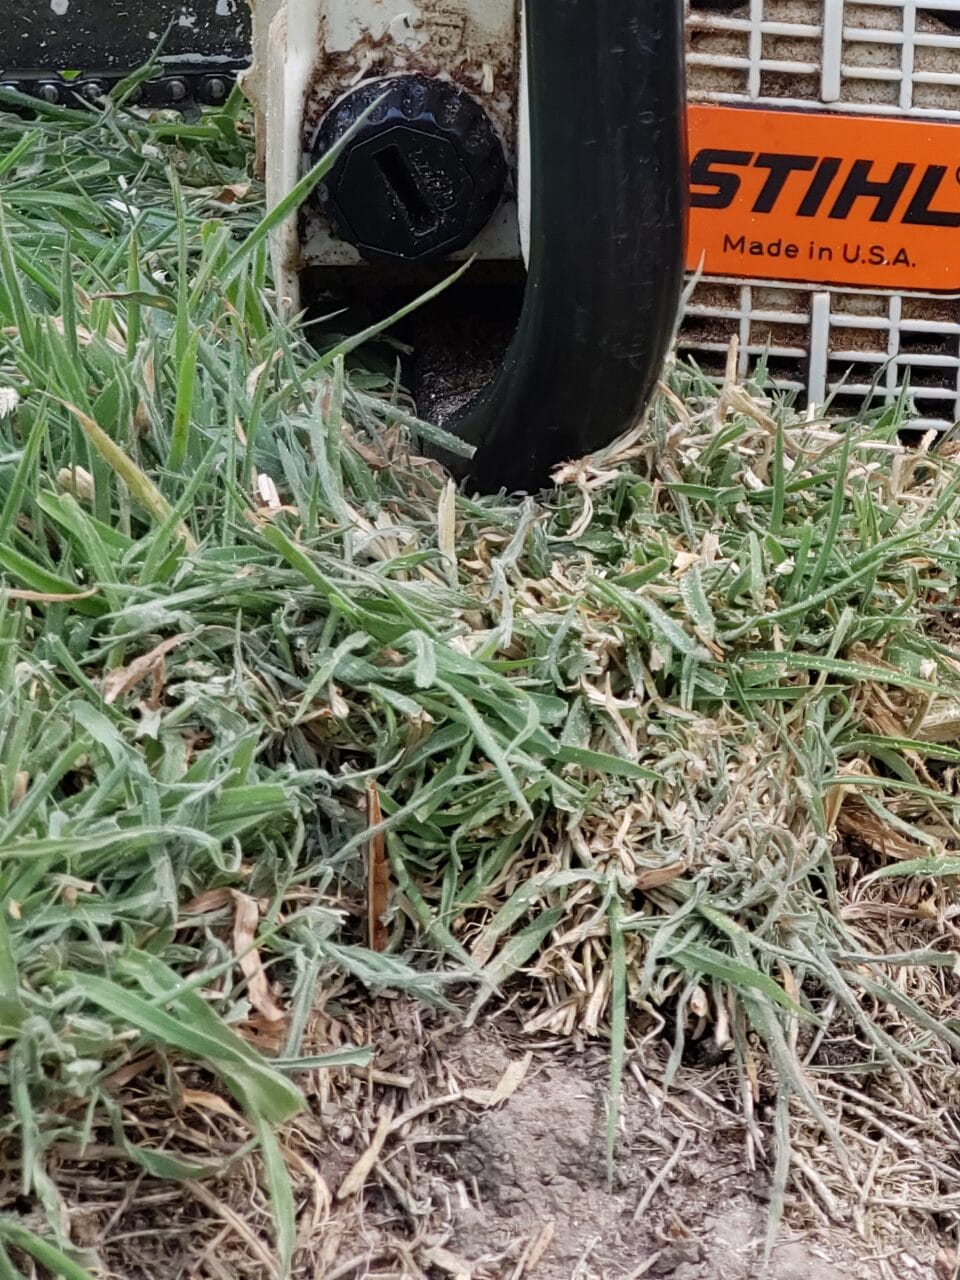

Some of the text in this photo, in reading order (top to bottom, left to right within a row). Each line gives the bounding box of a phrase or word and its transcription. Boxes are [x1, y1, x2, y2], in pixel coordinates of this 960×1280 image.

[723, 234, 917, 268] Made in U.S.A.
